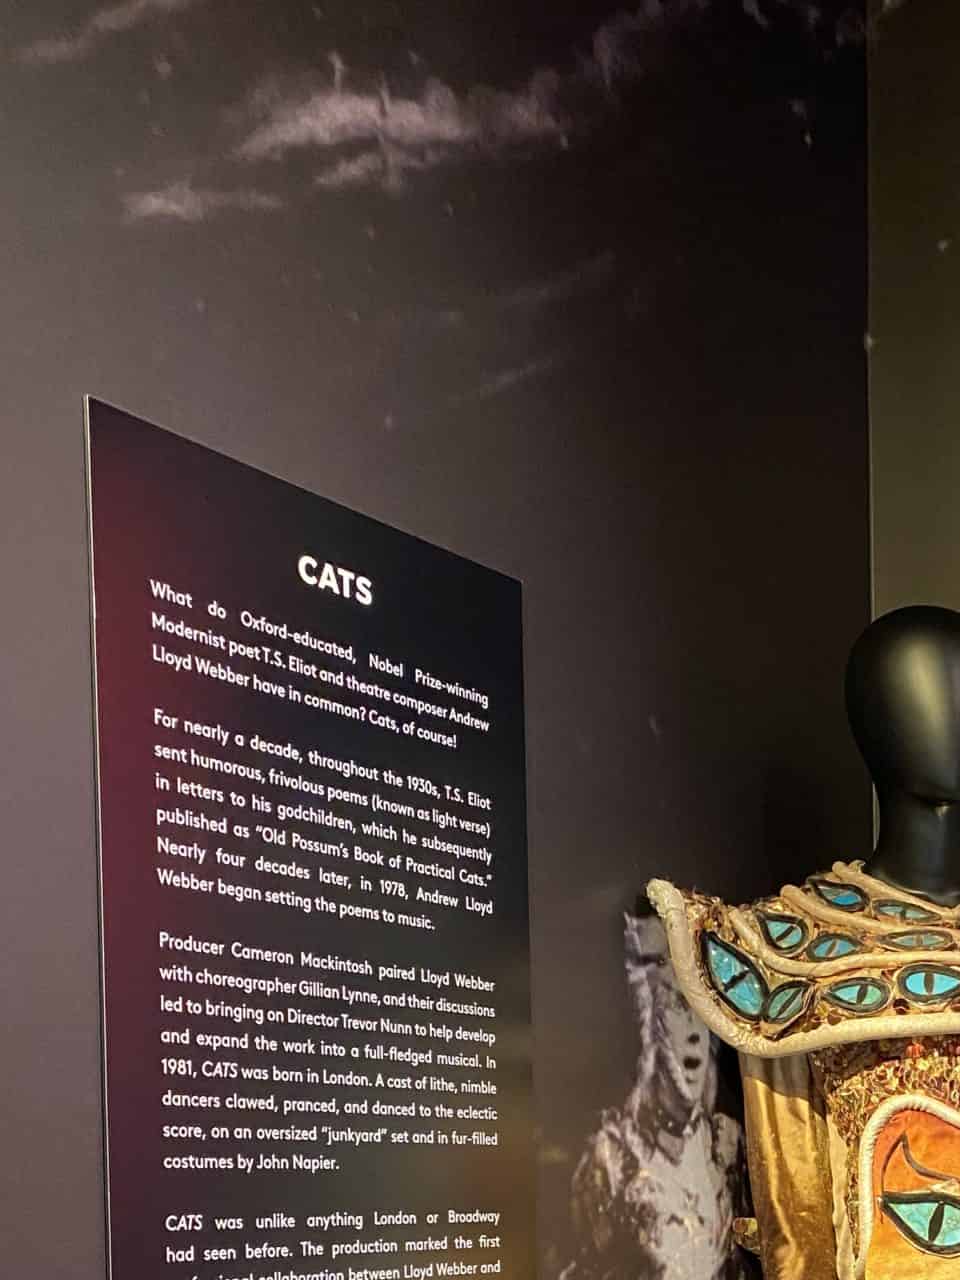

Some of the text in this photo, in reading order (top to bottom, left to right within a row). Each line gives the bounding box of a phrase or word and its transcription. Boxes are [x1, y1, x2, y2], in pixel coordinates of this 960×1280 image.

[297, 555, 373, 606] CATS
[149, 578, 489, 710] What do Oxford-educated, Nobel Prize-winning
[152, 643, 457, 749] Lloyd Webber have in common? Cats, of course!
[154, 708, 492, 811] For nearly a decade, throughout the 1930s, T.S. Eliot
[155, 772, 493, 866] in letters to his godchildren, which he subsequently
[156, 807, 492, 887] published as “Old Possum’s Book of Practical Cats.”
[156, 836, 493, 917] Nearly four decades later, in 1978, Andrew Lloyd
[156, 867, 436, 930] Webber began setting the poems to music.
[159, 931, 496, 992] Producer Cameron Mackintosh paired Lloyd Webber
[160, 1028, 497, 1069] and expand the work into a full-fledged musical. In
[161, 1089, 498, 1120] dancers clawed, pranced, and danced to the eclectic
[163, 1153, 340, 1174] costumes by John Napier.
[165, 1209, 500, 1232] CATS was unlike anything London or Broadway
[166, 1234, 501, 1263] had seen before. The production marked the first
[403, 1263, 433, 1280] Lloyd
[435, 1261, 478, 1276] Webber
[480, 1259, 501, 1274] and
